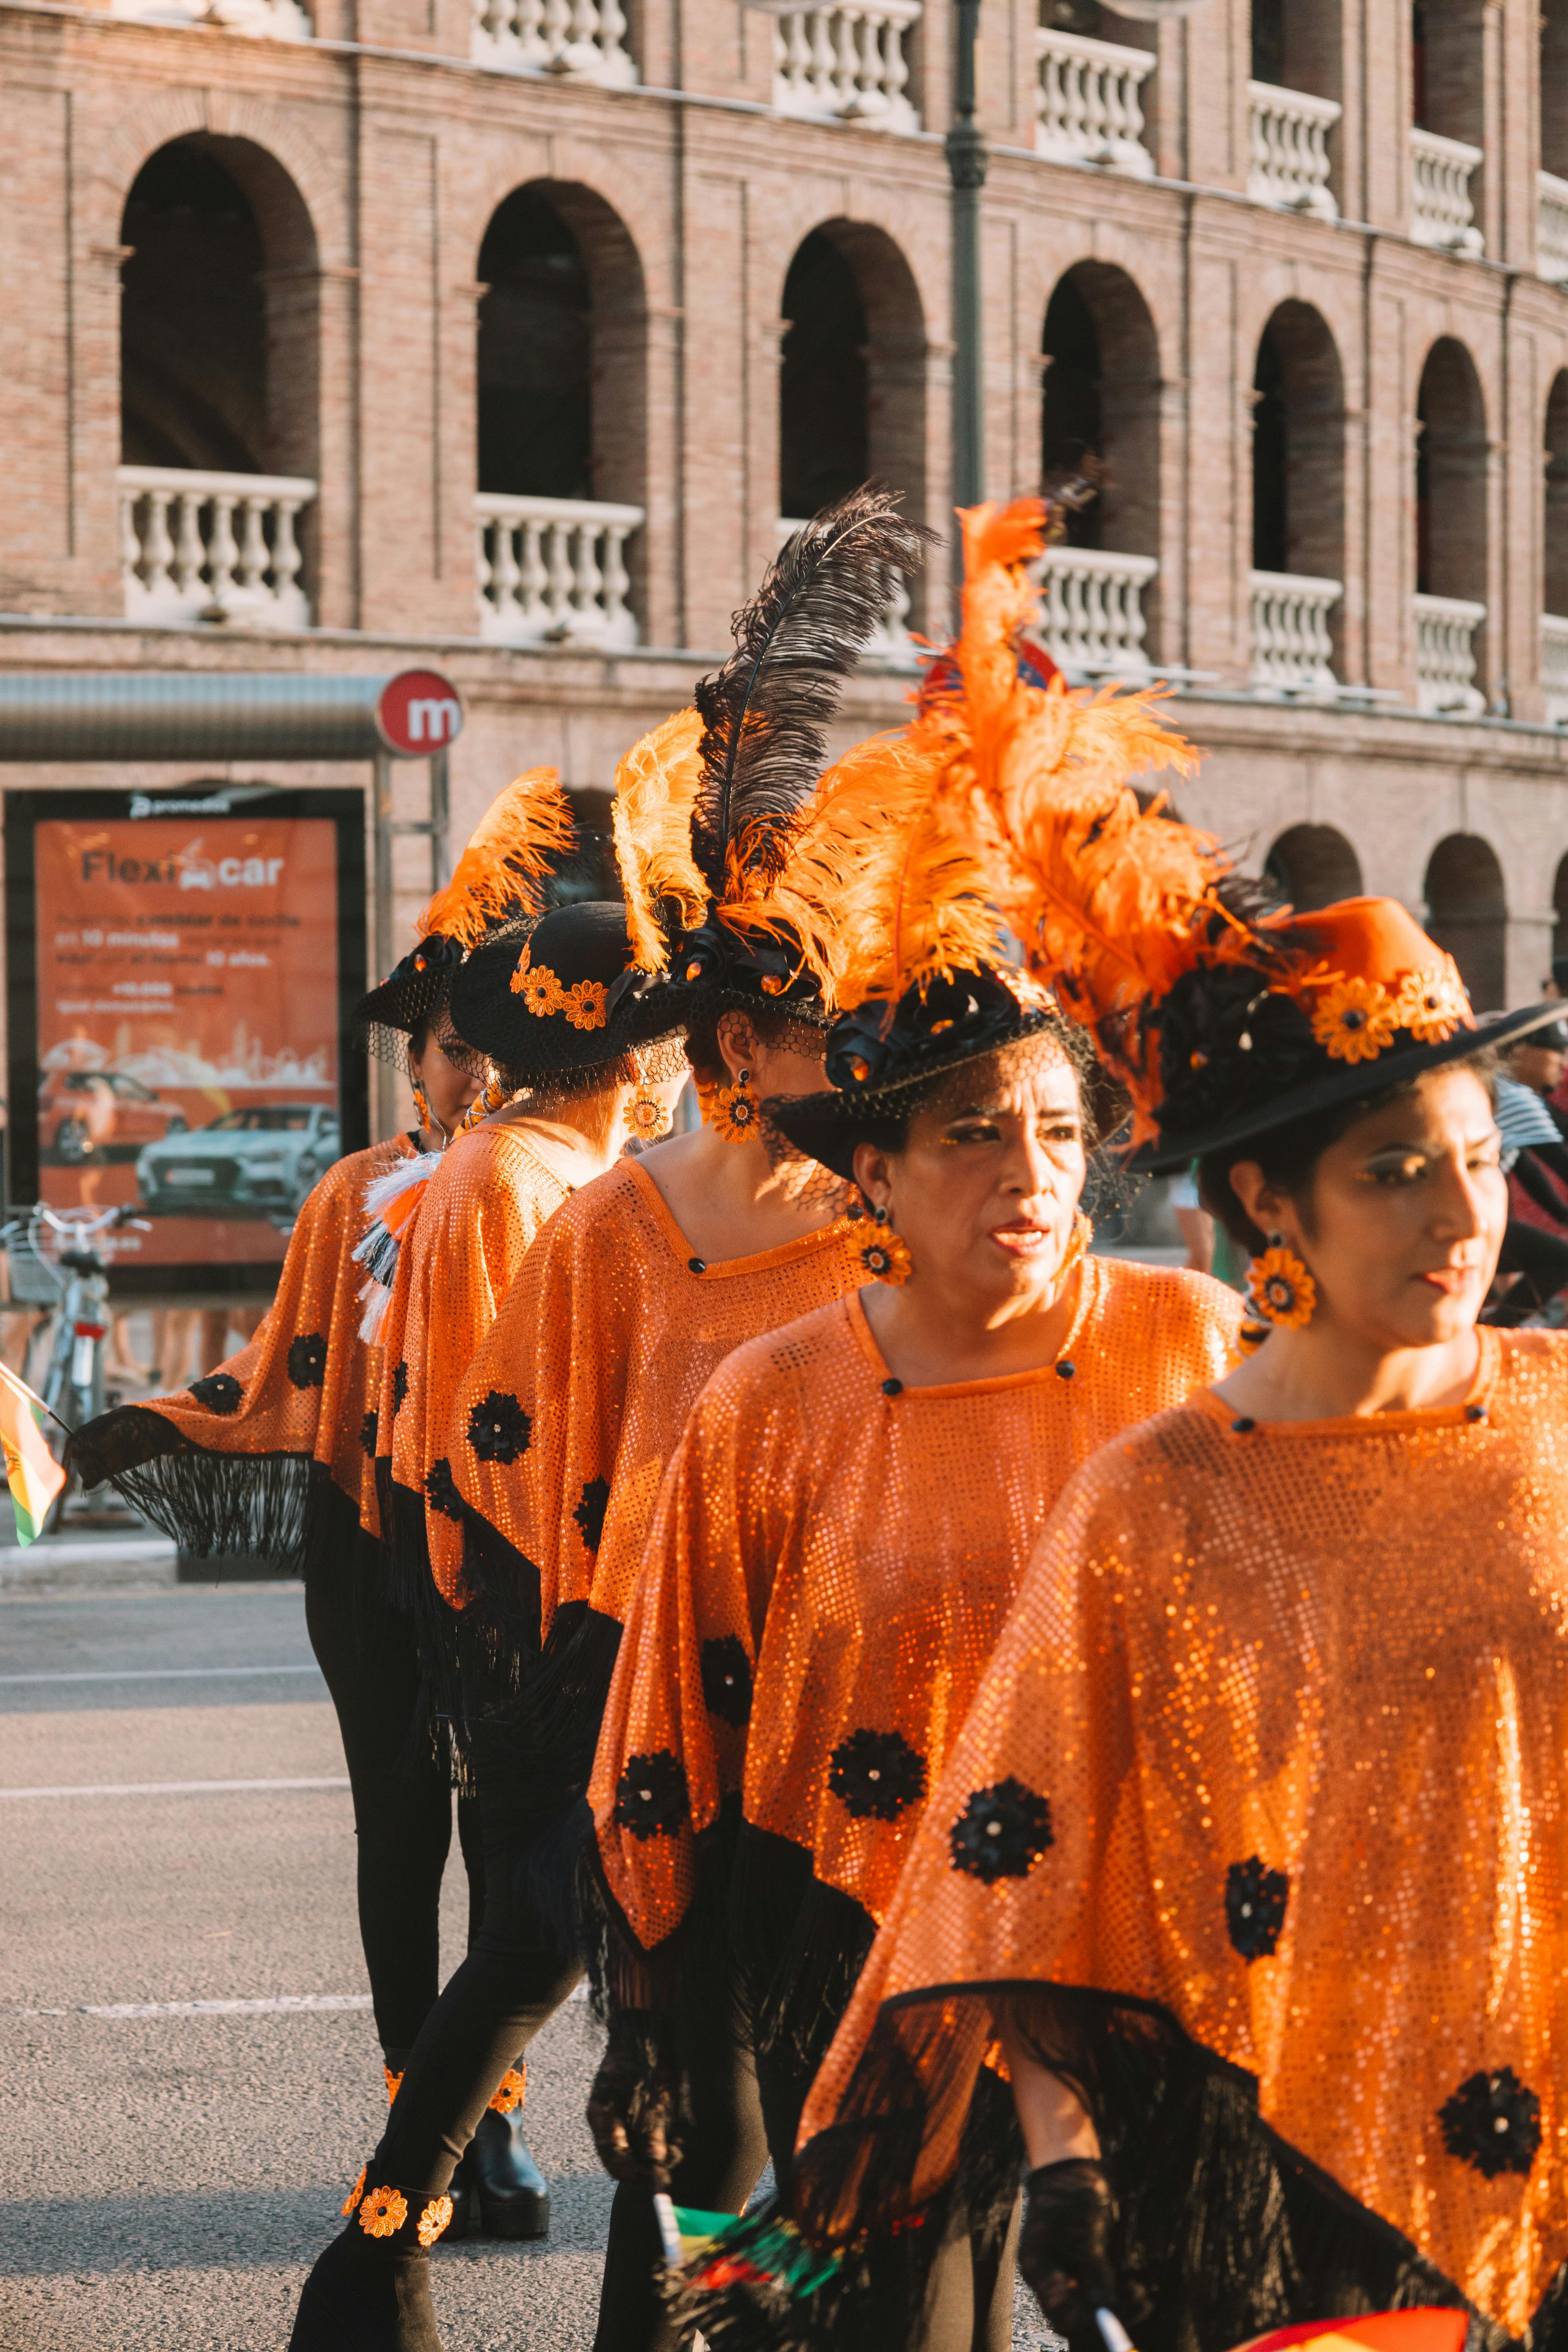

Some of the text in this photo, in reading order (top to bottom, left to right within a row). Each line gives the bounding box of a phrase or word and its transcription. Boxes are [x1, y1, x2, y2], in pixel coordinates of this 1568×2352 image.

[82, 851, 284, 886] Flexi car
[107, 931, 179, 948] minutos
